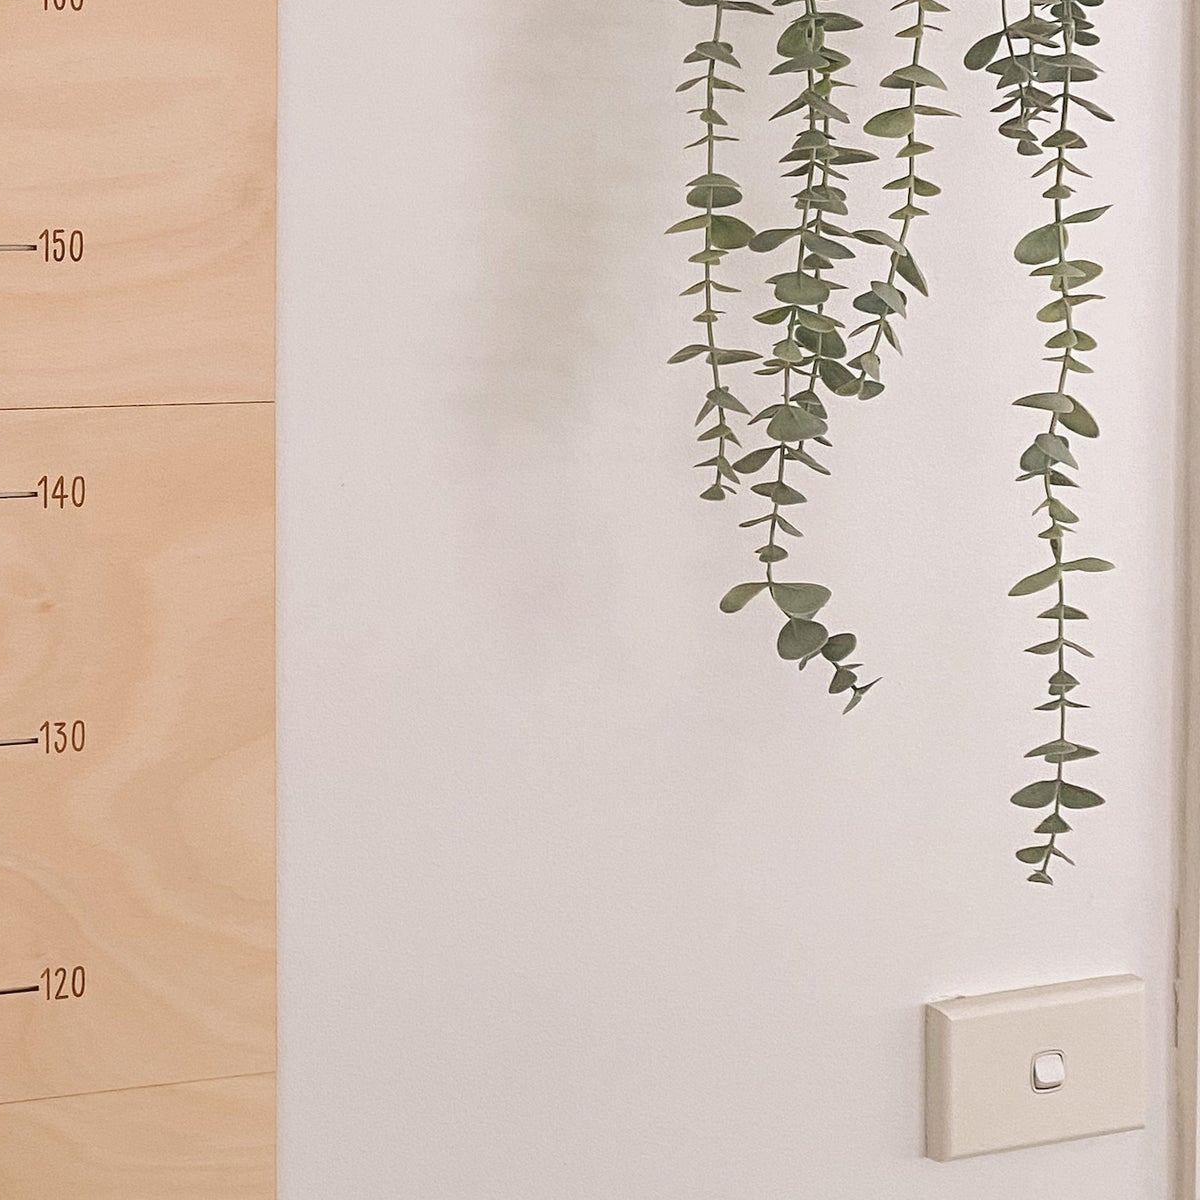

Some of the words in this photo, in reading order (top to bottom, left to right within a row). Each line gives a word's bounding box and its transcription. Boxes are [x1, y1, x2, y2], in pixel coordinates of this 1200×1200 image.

[37, 228, 85, 263] 150
[37, 475, 87, 510] 140
[39, 719, 87, 755] 130
[39, 965, 87, 1001] 120
